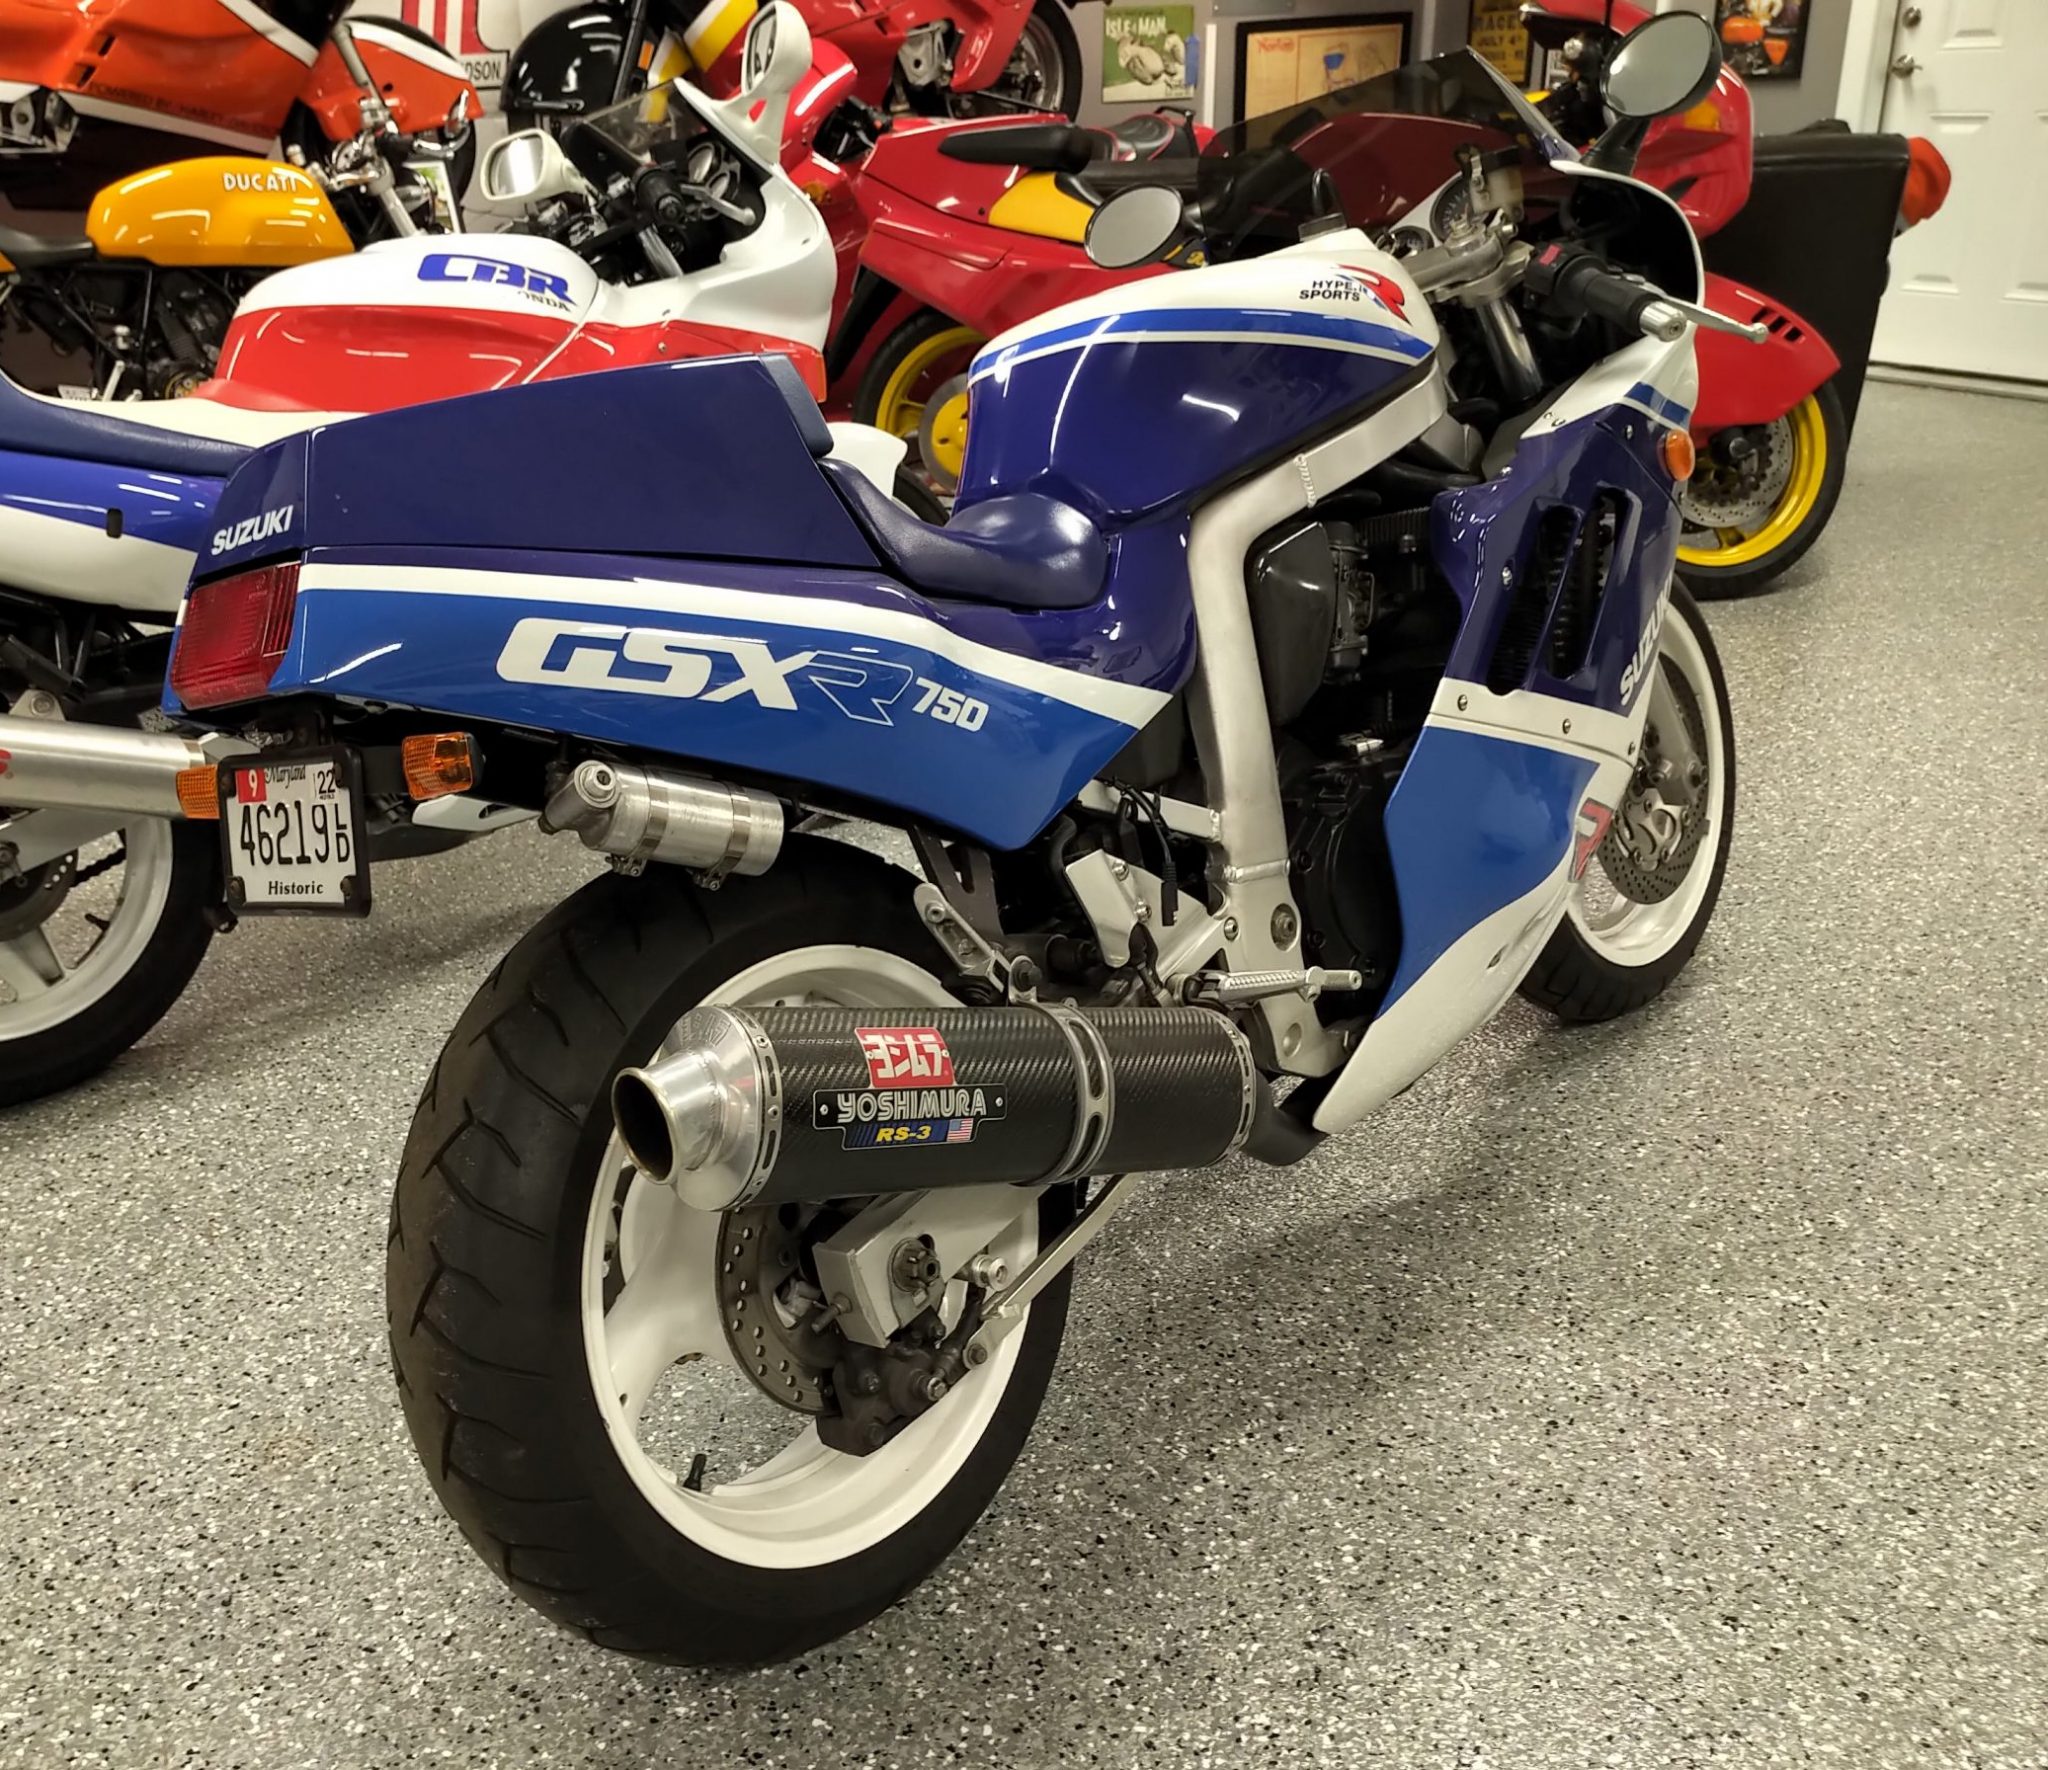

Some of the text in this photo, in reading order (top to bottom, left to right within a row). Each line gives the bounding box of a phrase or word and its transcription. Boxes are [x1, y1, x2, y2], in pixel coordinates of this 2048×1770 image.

[223, 172, 297, 192] DUCATI
[417, 253, 577, 306] CBR
[1299, 289, 1361, 302] SPORTS
[211, 504, 294, 556] SUZUKI
[912, 677, 989, 732] 750
[265, 765, 306, 789] Maryland
[317, 769, 336, 795] 22
[268, 880, 324, 895] Historic
[861, 1034, 946, 1078] ヨシムラ
[837, 1089, 987, 1124] YOSHIMURA
[876, 1126, 932, 1143] RS-3
